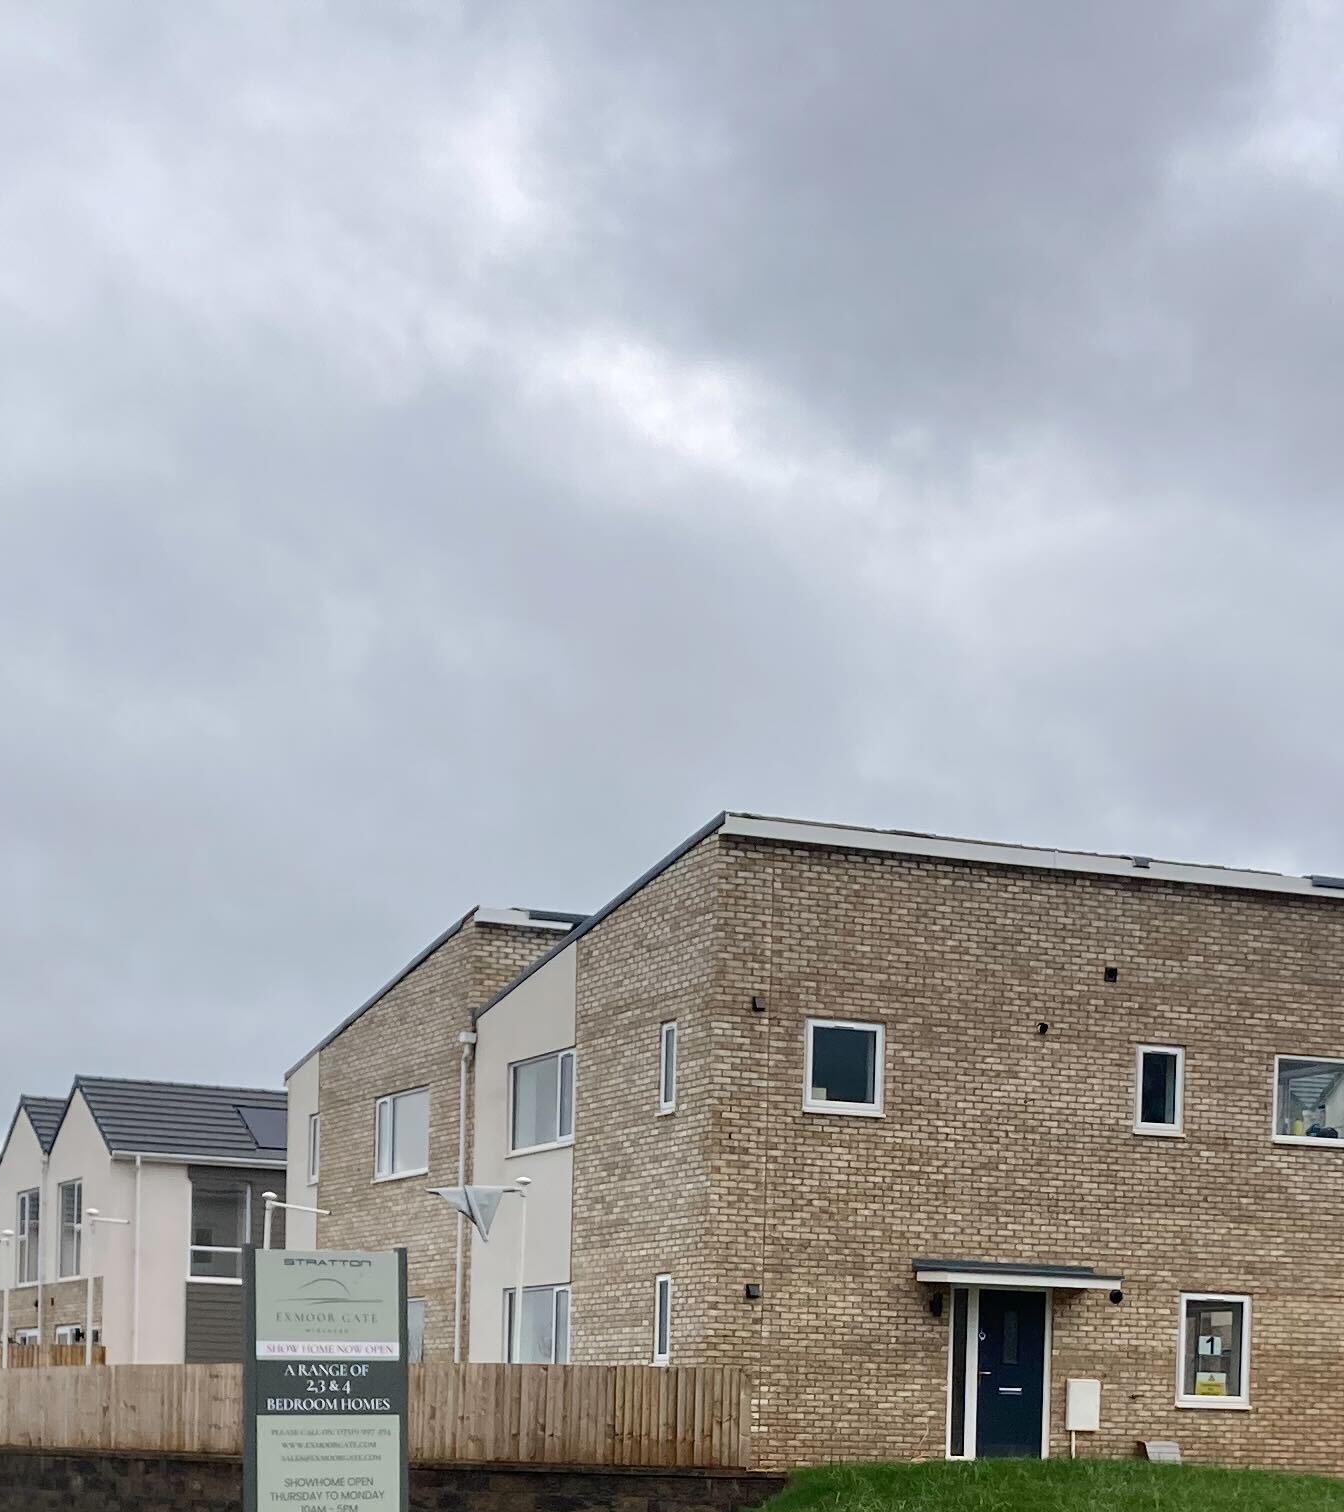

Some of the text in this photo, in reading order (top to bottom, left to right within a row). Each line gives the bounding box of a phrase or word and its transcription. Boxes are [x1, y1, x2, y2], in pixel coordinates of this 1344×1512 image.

[276, 1312, 335, 1322] EXMOOR
[266, 1344, 393, 1354] SHOW HOME NOW OPEN
[1206, 1337, 1215, 1354] 1
[284, 1364, 369, 1376] A RANGE OF
[306, 1380, 351, 1394] 2,3 & 4
[267, 1398, 391, 1411] BEDROOM HOMES
[284, 1477, 373, 1487] SHOWHOME OPEN
[270, 1490, 384, 1501] THURSDAY TO MONDAY
[337, 1504, 358, 1512] 5PM
